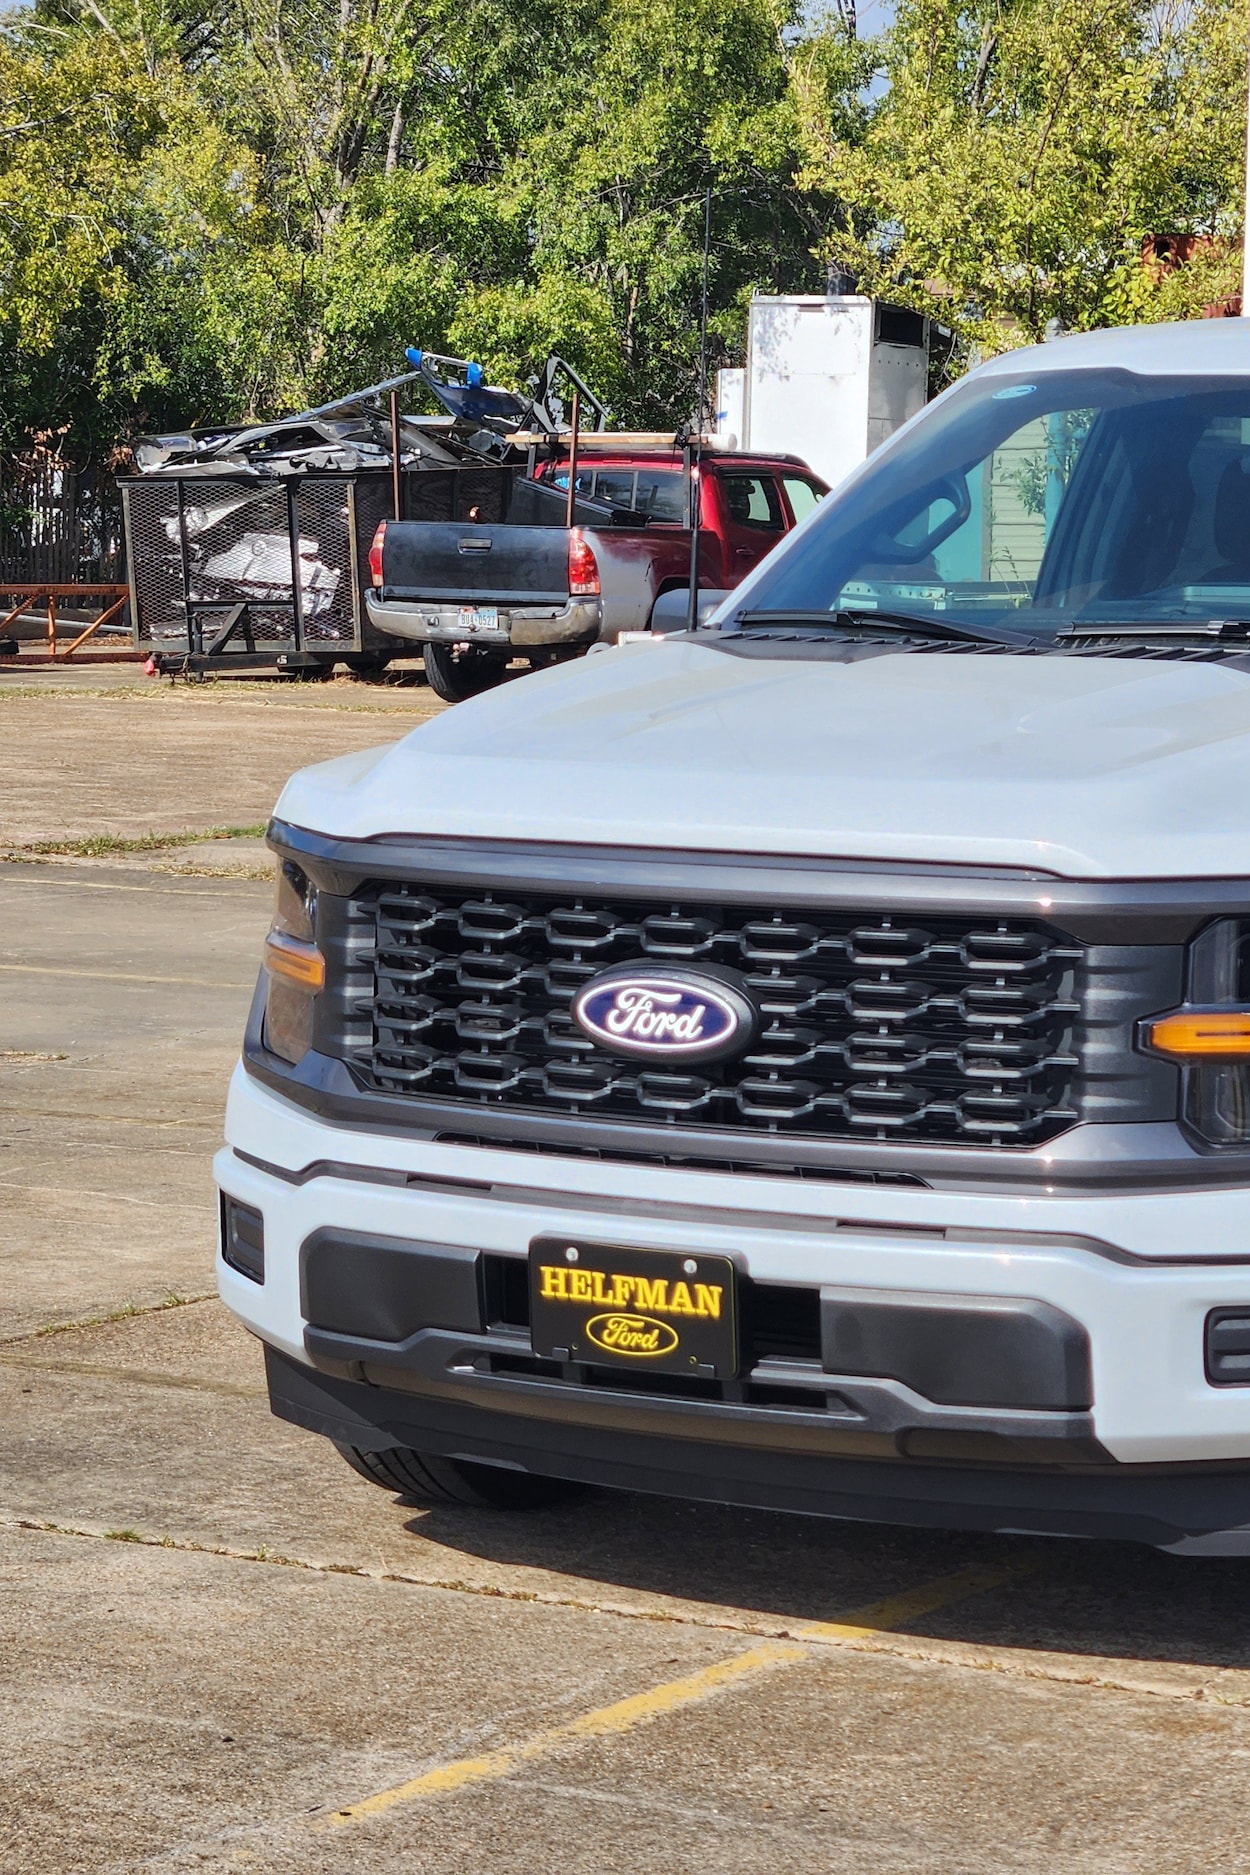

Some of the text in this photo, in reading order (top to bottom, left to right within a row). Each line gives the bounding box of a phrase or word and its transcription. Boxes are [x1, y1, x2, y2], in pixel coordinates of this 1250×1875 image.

[607, 987, 706, 1039] Ford
[540, 1266, 722, 1319] HELFMAN
[603, 1317, 660, 1349] Ford
